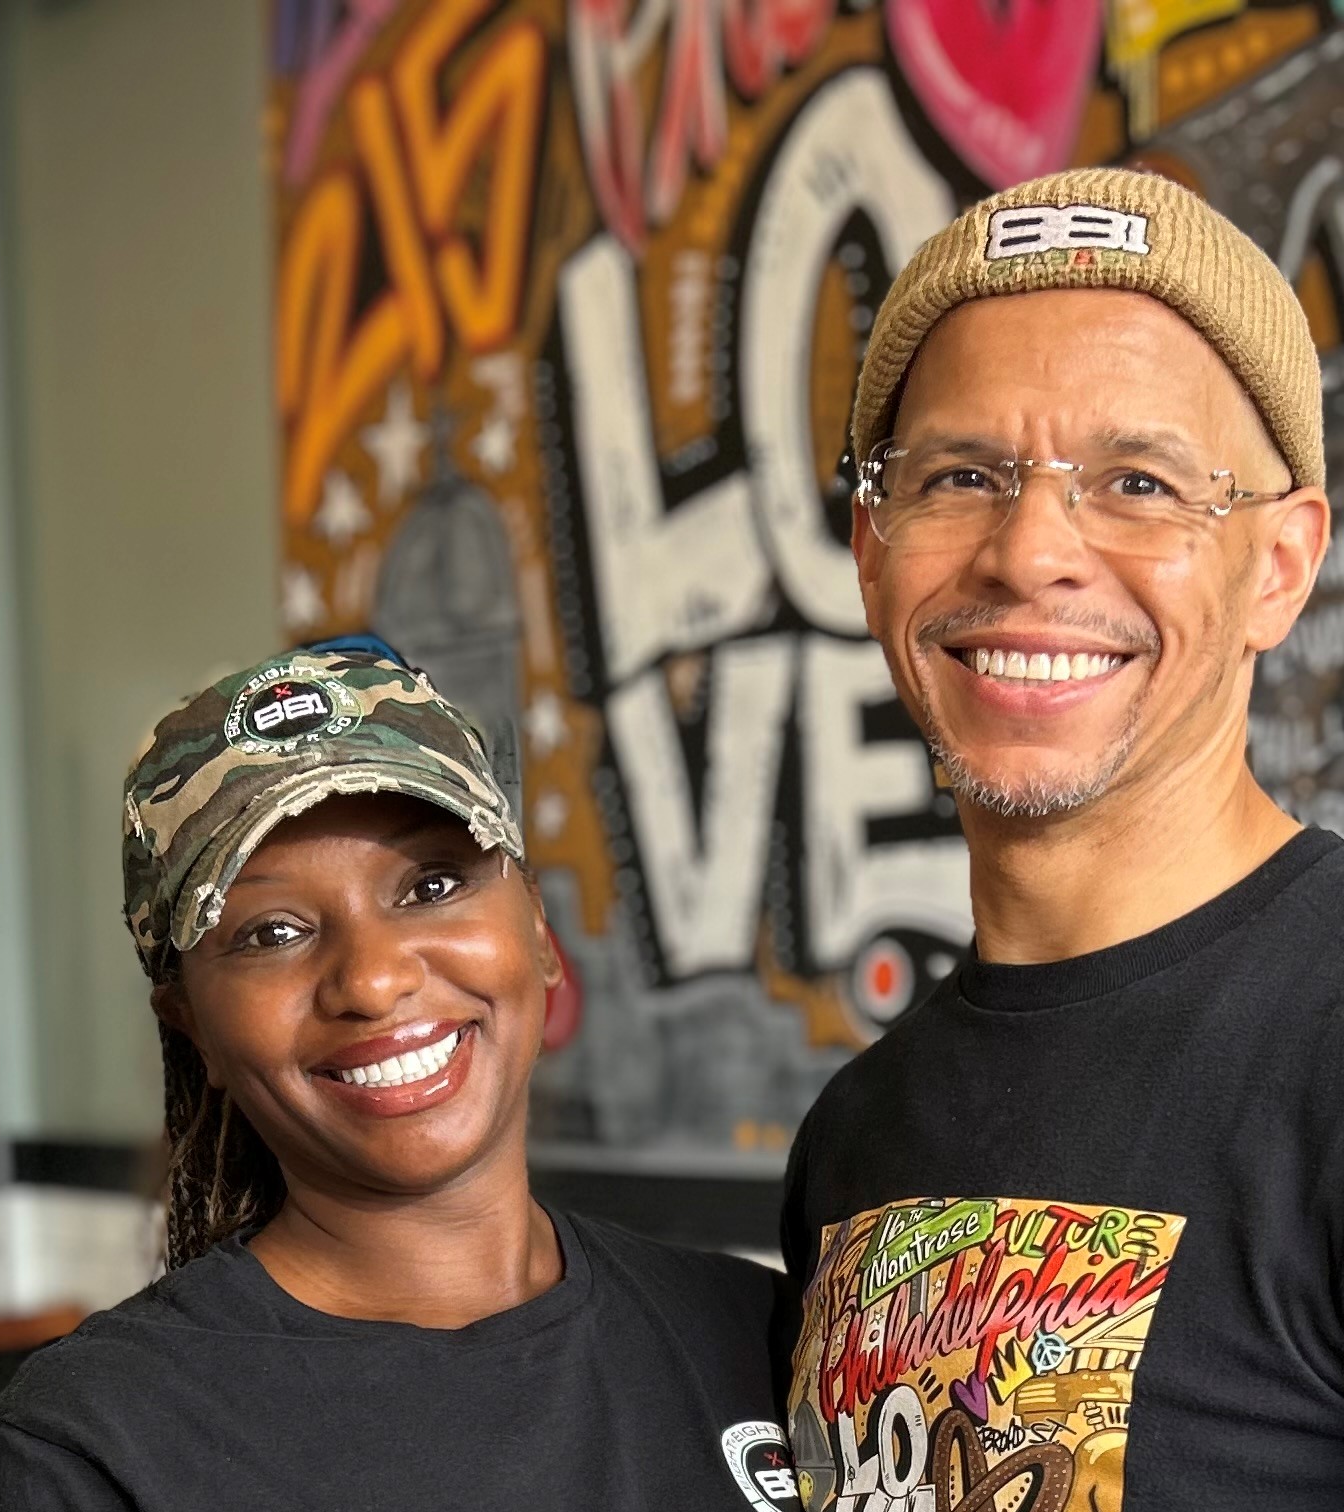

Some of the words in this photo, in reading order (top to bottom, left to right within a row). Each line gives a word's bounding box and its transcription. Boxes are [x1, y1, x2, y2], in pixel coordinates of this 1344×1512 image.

[984, 204, 1151, 260] 881
[253, 692, 329, 731] 881
[868, 1211, 980, 1298] Montrose
[819, 1240, 1171, 1422] Philadelphia
